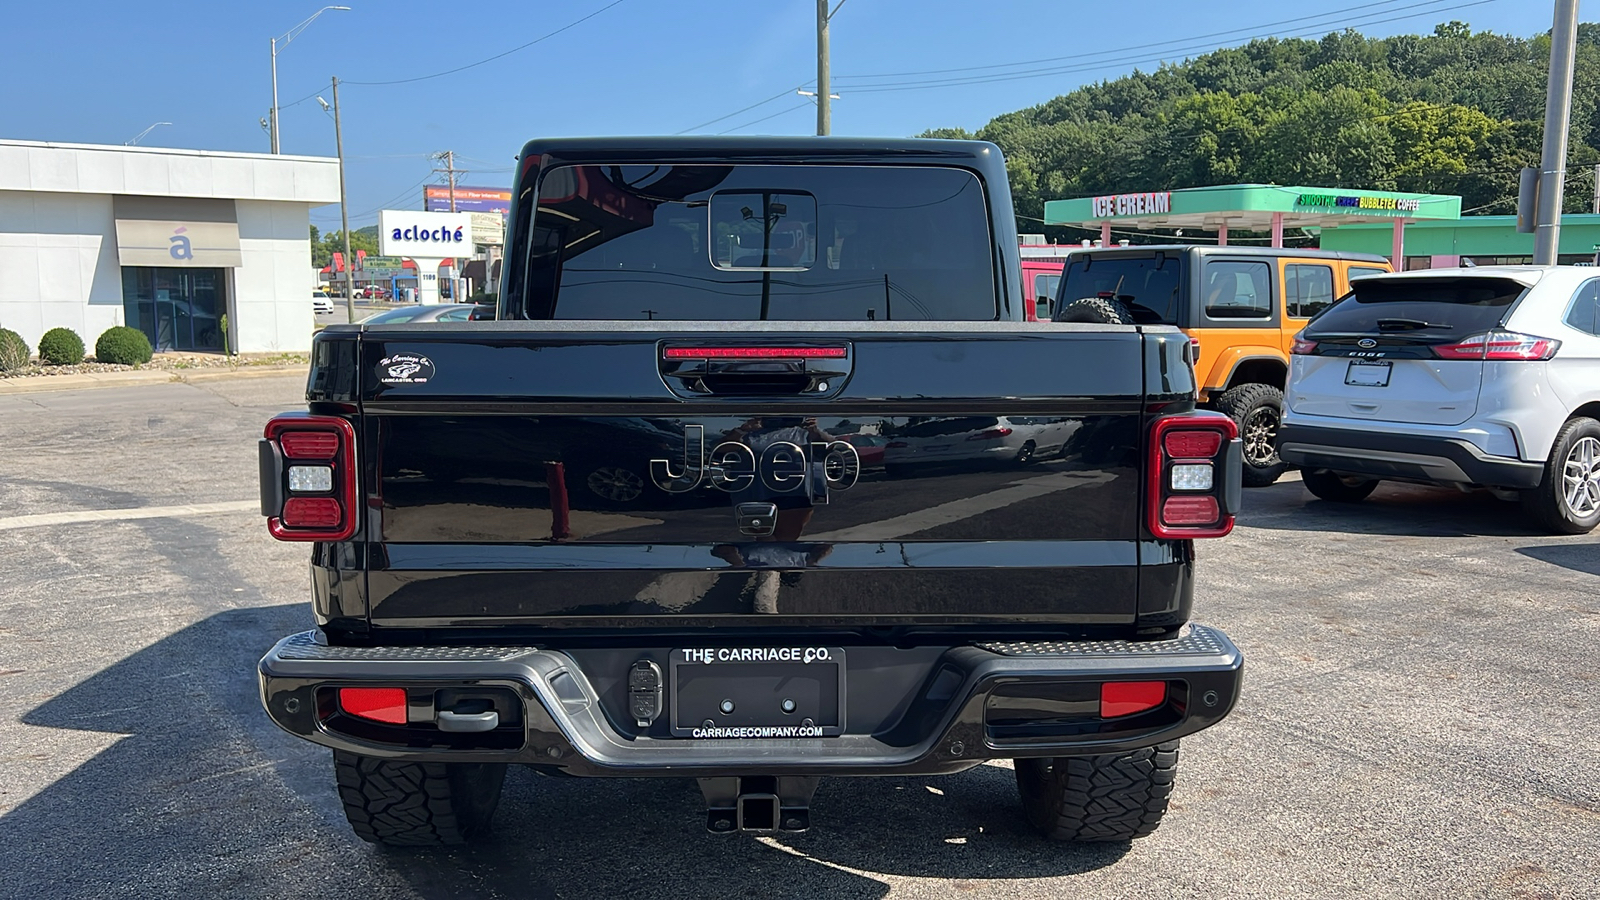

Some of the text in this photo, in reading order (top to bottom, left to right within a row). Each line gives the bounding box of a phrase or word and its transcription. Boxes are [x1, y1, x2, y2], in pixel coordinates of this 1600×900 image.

[1092, 192, 1171, 218] ICE CREAM
[1300, 194, 1336, 207] SMOOTHIE
[1397, 199, 1420, 211] COFFEE
[392, 225, 463, 242] acloché
[169, 226, 193, 260] á
[650, 424, 860, 504] Jeep
[682, 648, 832, 662] THE CARRIAGE CO.
[692, 727, 823, 738] CARRIAGECOMPANY.COM
